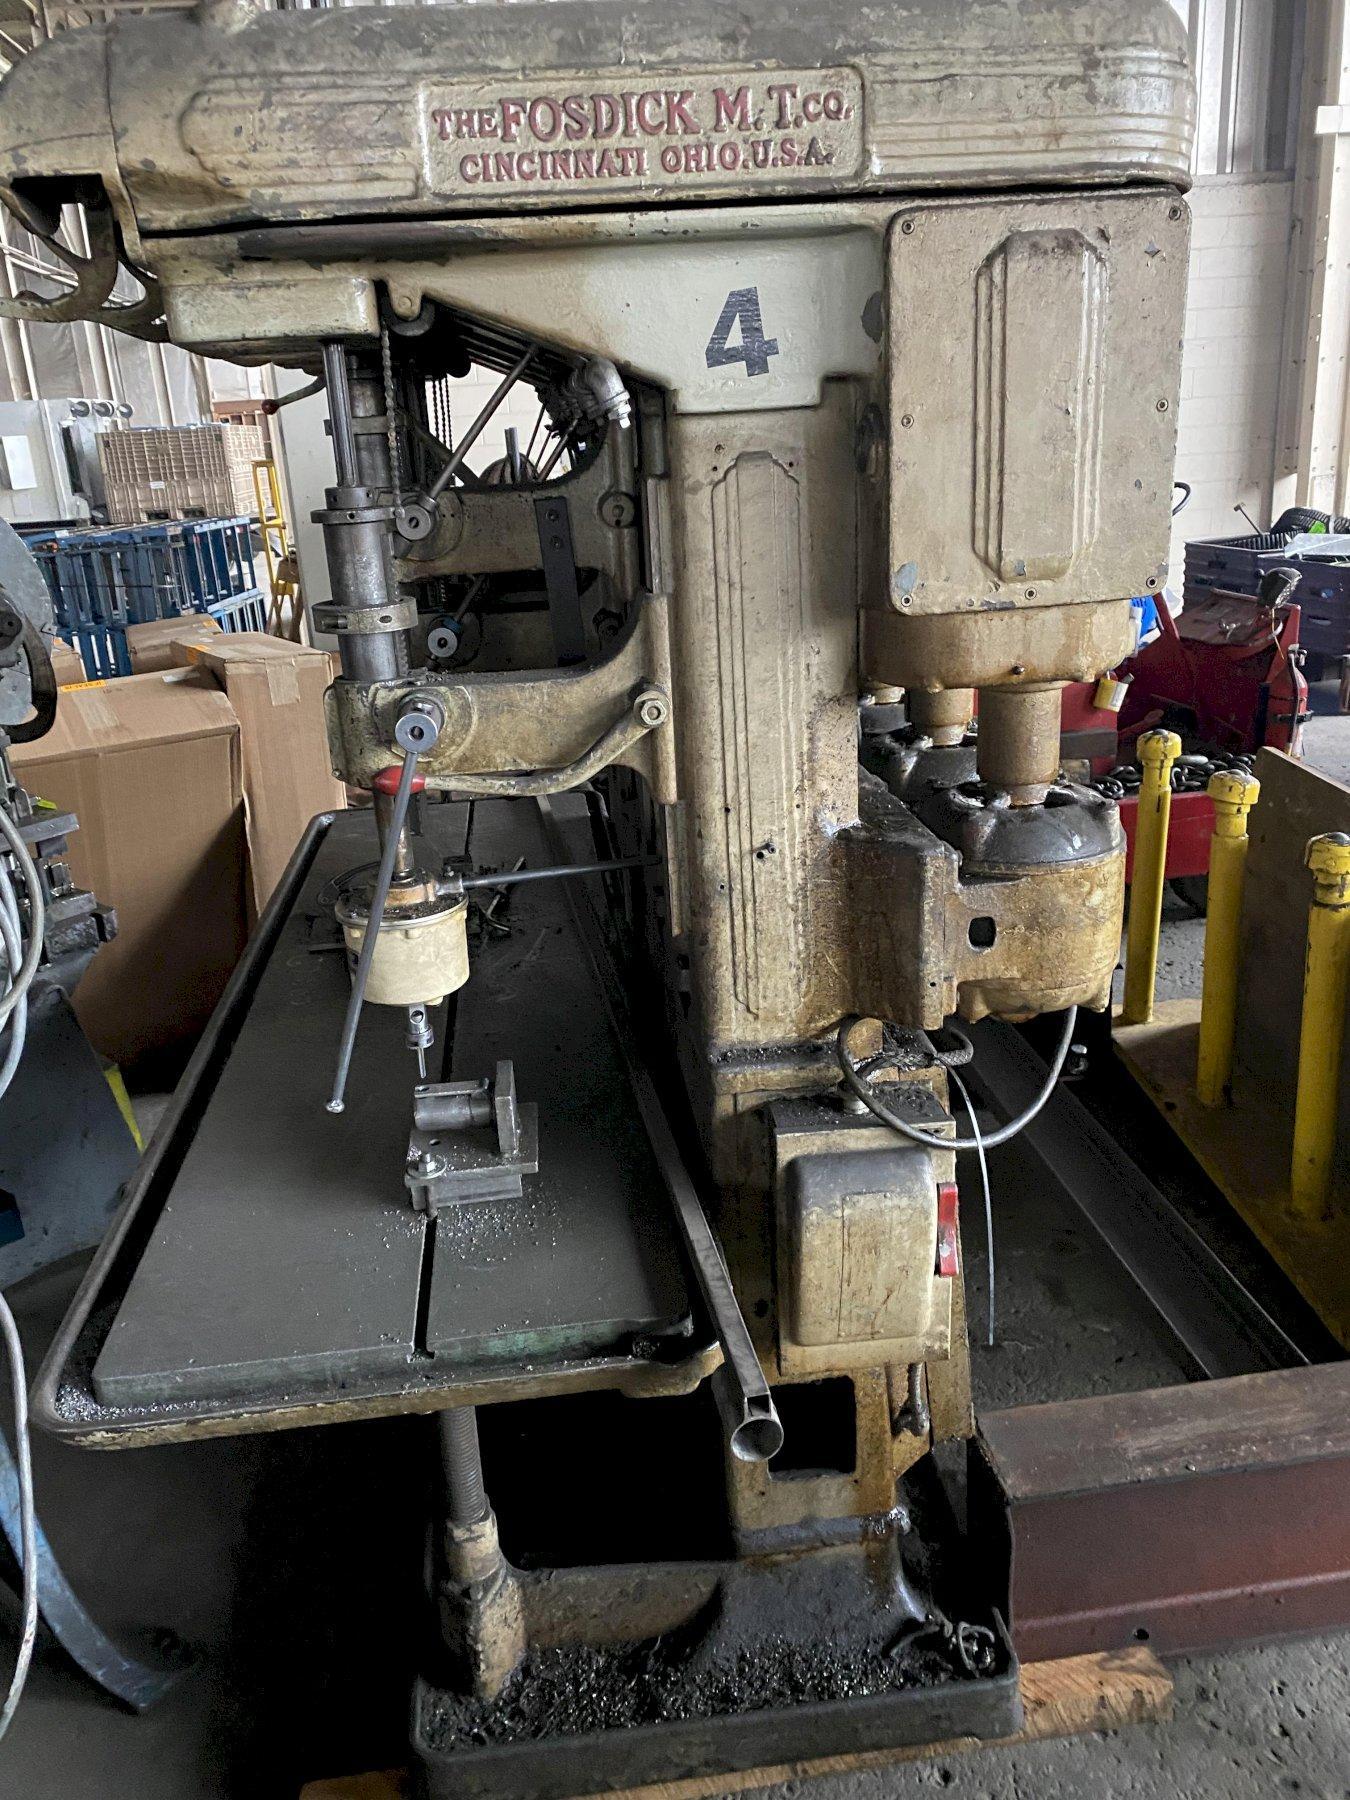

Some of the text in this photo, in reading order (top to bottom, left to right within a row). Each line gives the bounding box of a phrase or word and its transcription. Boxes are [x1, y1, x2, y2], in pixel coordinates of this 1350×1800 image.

[432, 108, 499, 141] THE
[499, 89, 702, 143] FOSDICK
[459, 147, 647, 184] CINCINNATI
[705, 286, 779, 377] 4
